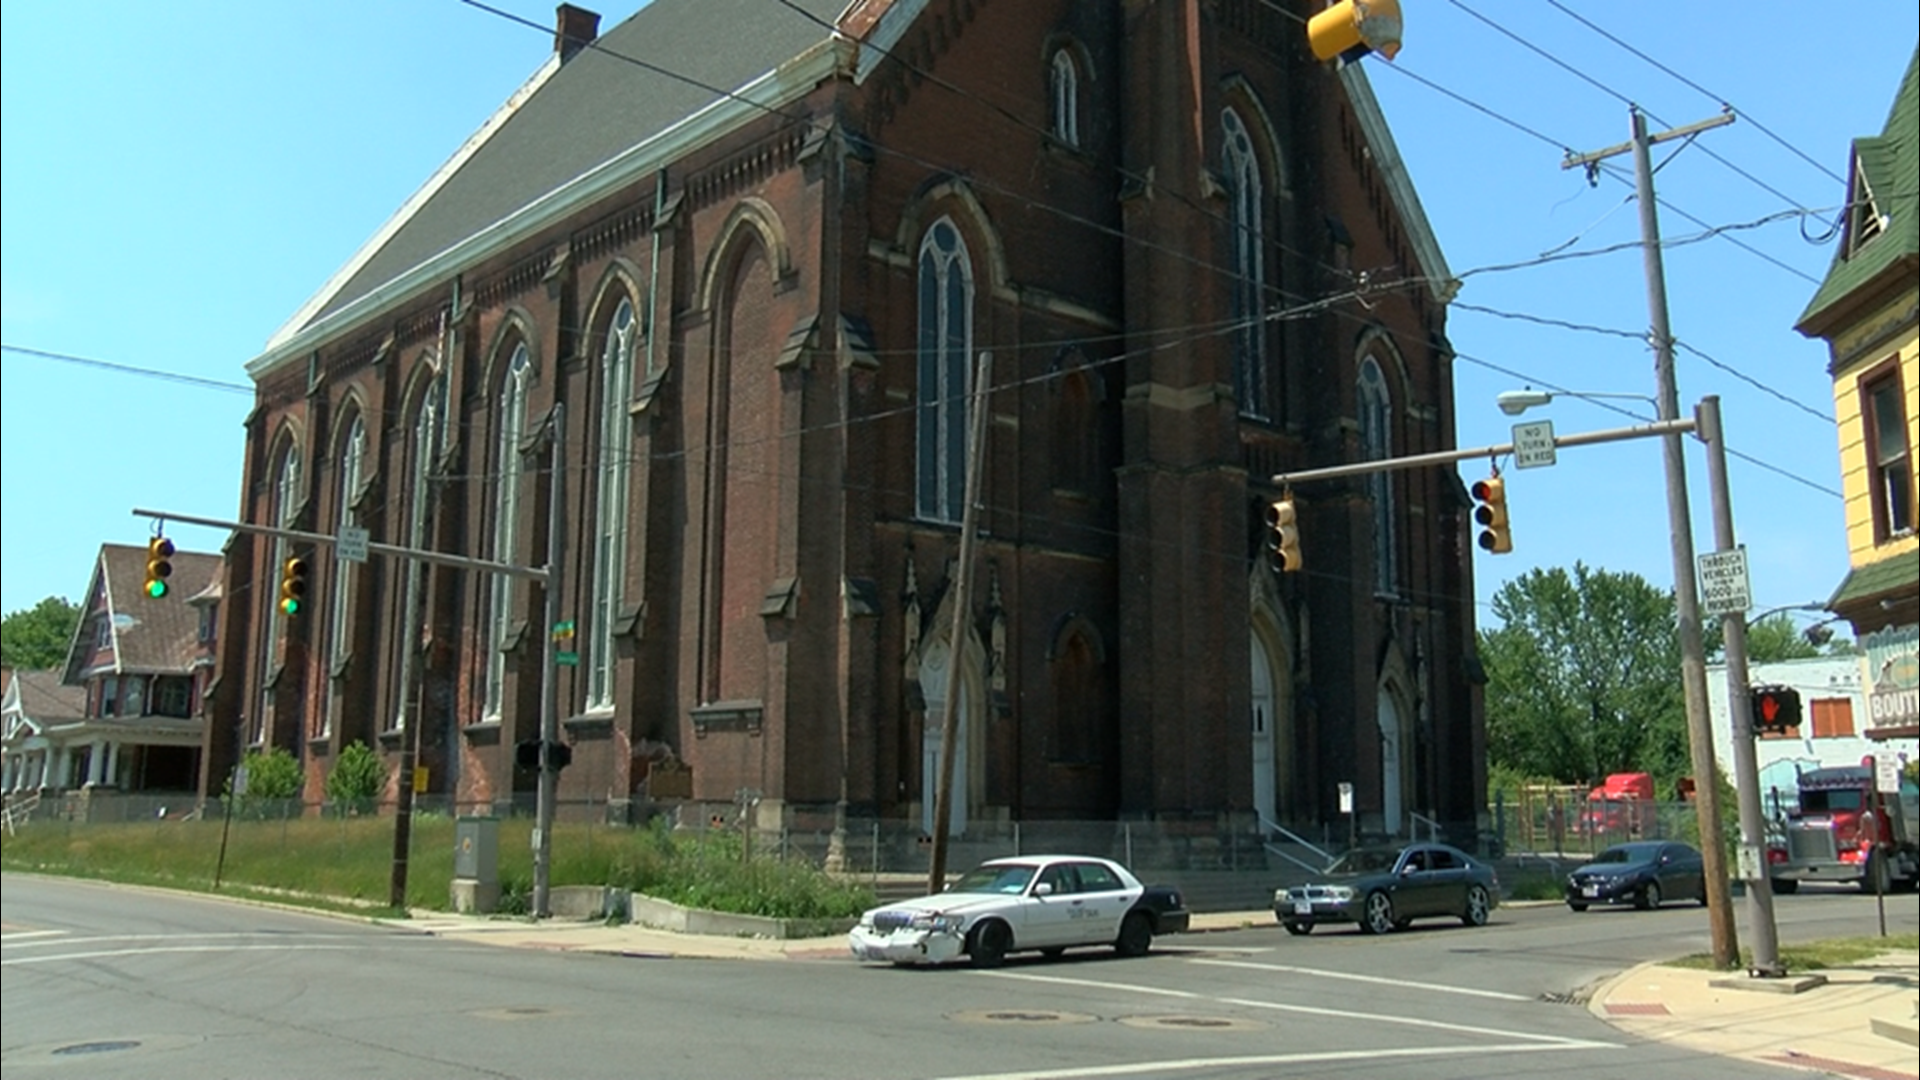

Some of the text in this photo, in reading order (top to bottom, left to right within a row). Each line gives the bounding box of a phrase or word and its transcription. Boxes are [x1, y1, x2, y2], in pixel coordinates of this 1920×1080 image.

[1524, 427, 1541, 438] NO
[1702, 555, 1741, 568] THROUGH
[1703, 566, 1743, 579] VEHICLES
